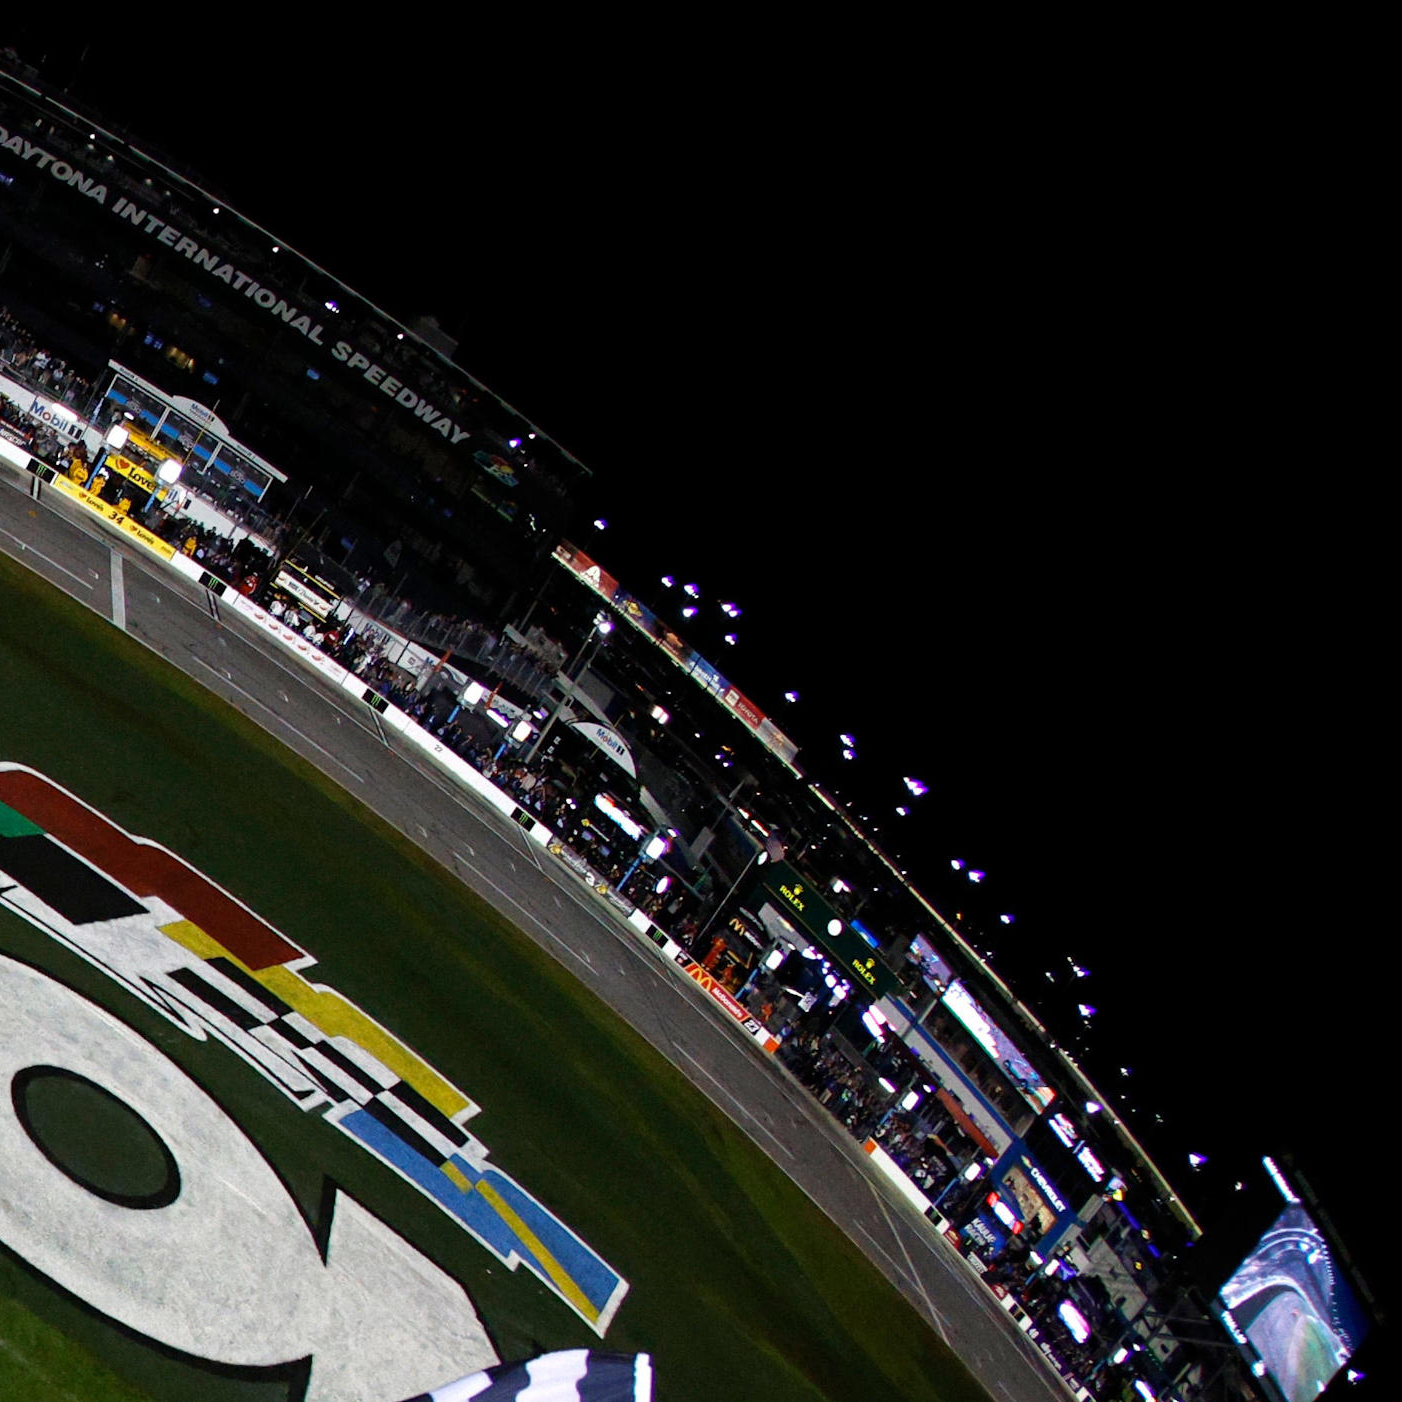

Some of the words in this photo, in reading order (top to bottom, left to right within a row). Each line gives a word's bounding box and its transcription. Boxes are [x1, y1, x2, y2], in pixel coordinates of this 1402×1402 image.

[112, 197, 325, 346] INTERNATIONAL
[331, 338, 470, 445] SPEEDWAY
[29, 401, 68, 431] Mobil
[107, 510, 124, 525] 34
[594, 727, 619, 751] Mobil
[777, 883, 806, 913] ROLEX
[851, 958, 877, 985] ROLEX
[1029, 1166, 1066, 1213] CHEVROLET
